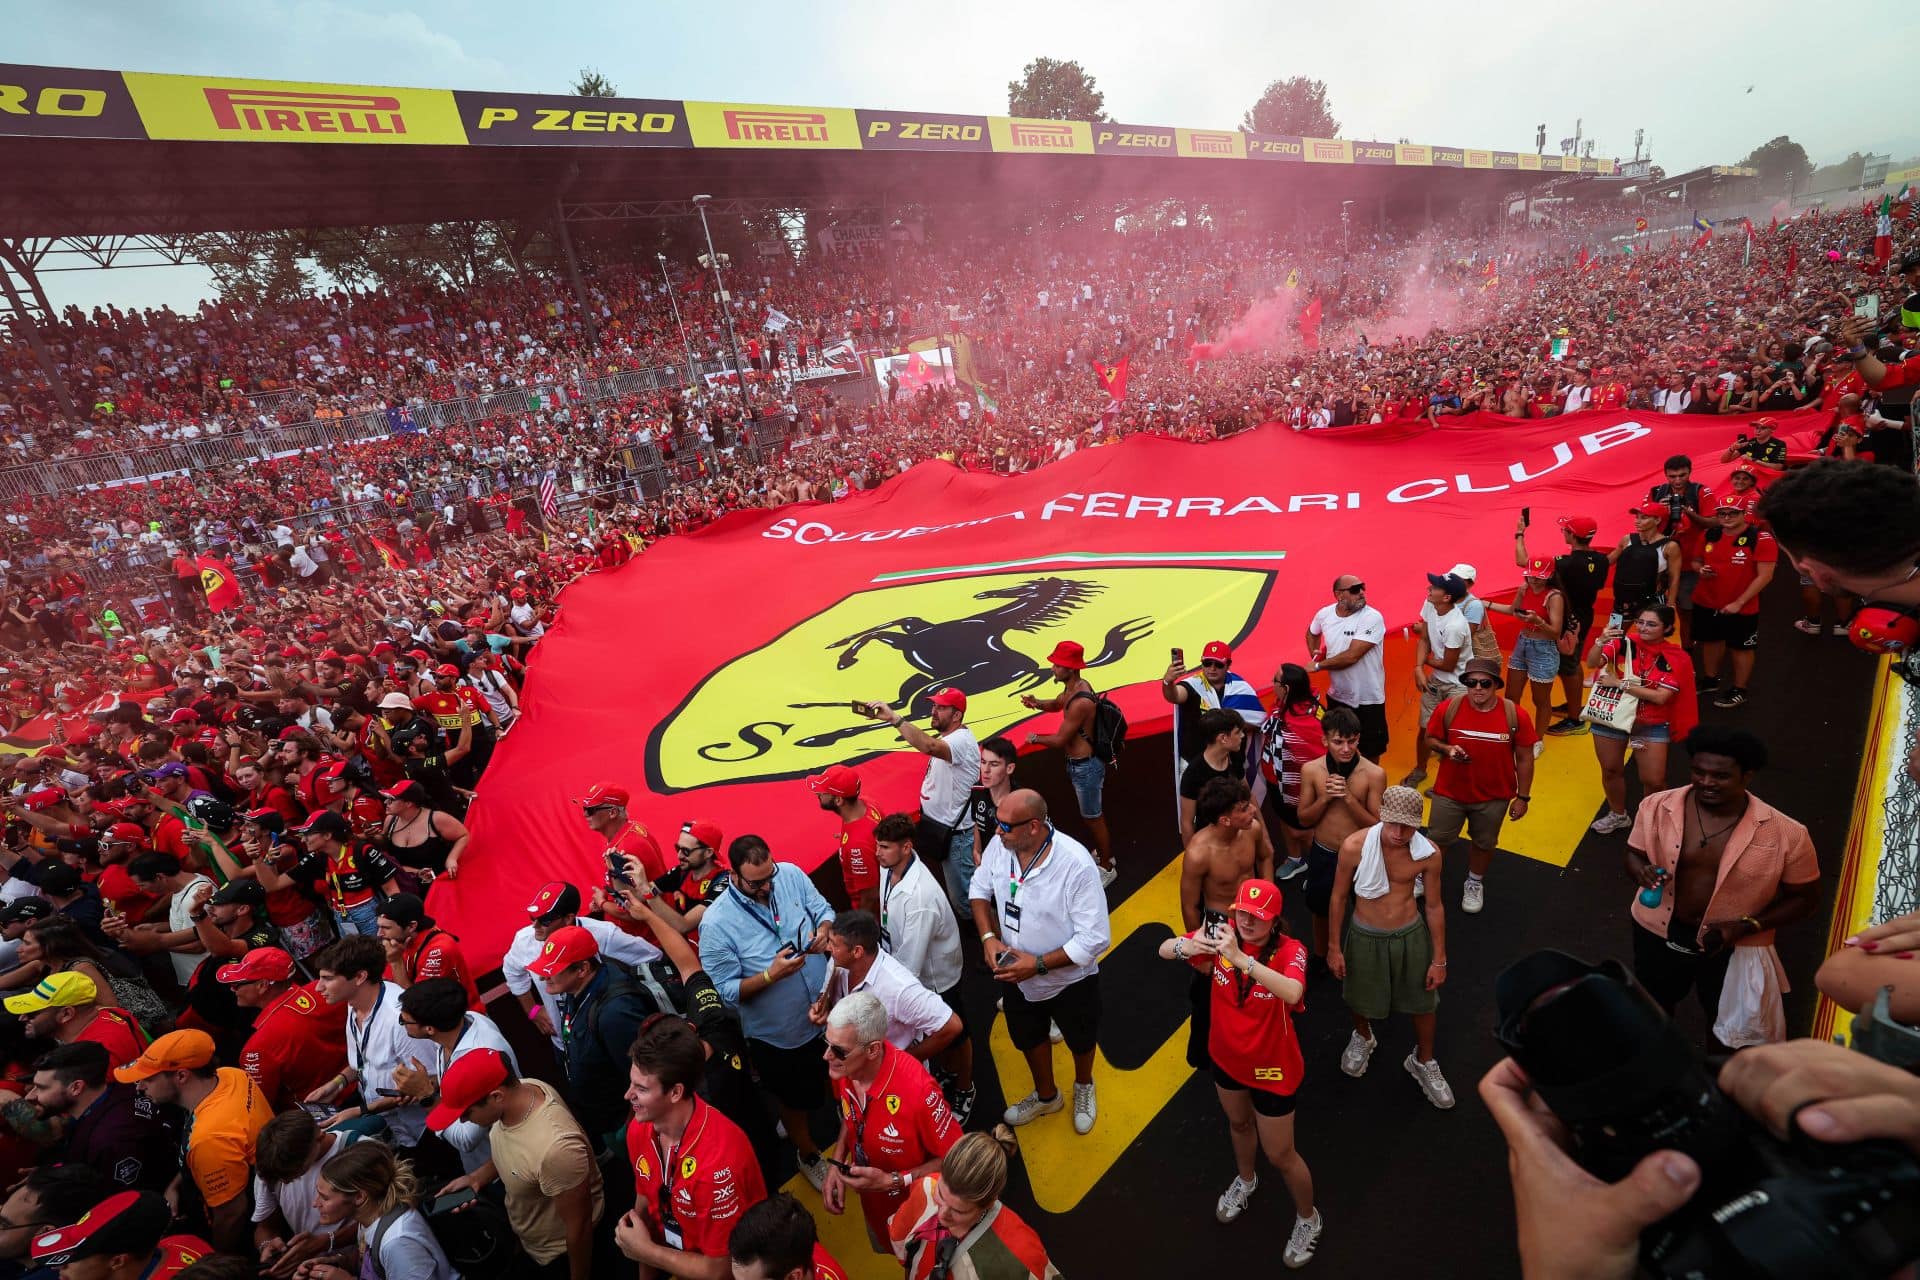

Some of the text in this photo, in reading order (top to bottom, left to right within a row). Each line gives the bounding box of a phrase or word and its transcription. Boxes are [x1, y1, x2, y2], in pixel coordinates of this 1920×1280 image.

[203, 87, 407, 134] PIRELLI
[478, 107, 676, 133] P ZERO
[723, 110, 829, 141] PIRELLI
[868, 120, 982, 141] P ZERO
[1010, 123, 1074, 148] PIRELLI
[1098, 132, 1171, 148] P ZERO
[1190, 133, 1233, 154] PIRELLI
[1250, 140, 1300, 155] P ZERO
[1365, 148, 1393, 159] ZERO
[761, 421, 1652, 545] SCUDEA FERRARI CLUB
[1254, 1067, 1284, 1081] 55
[713, 1166, 732, 1184] aws
[713, 1182, 735, 1201] DXC
